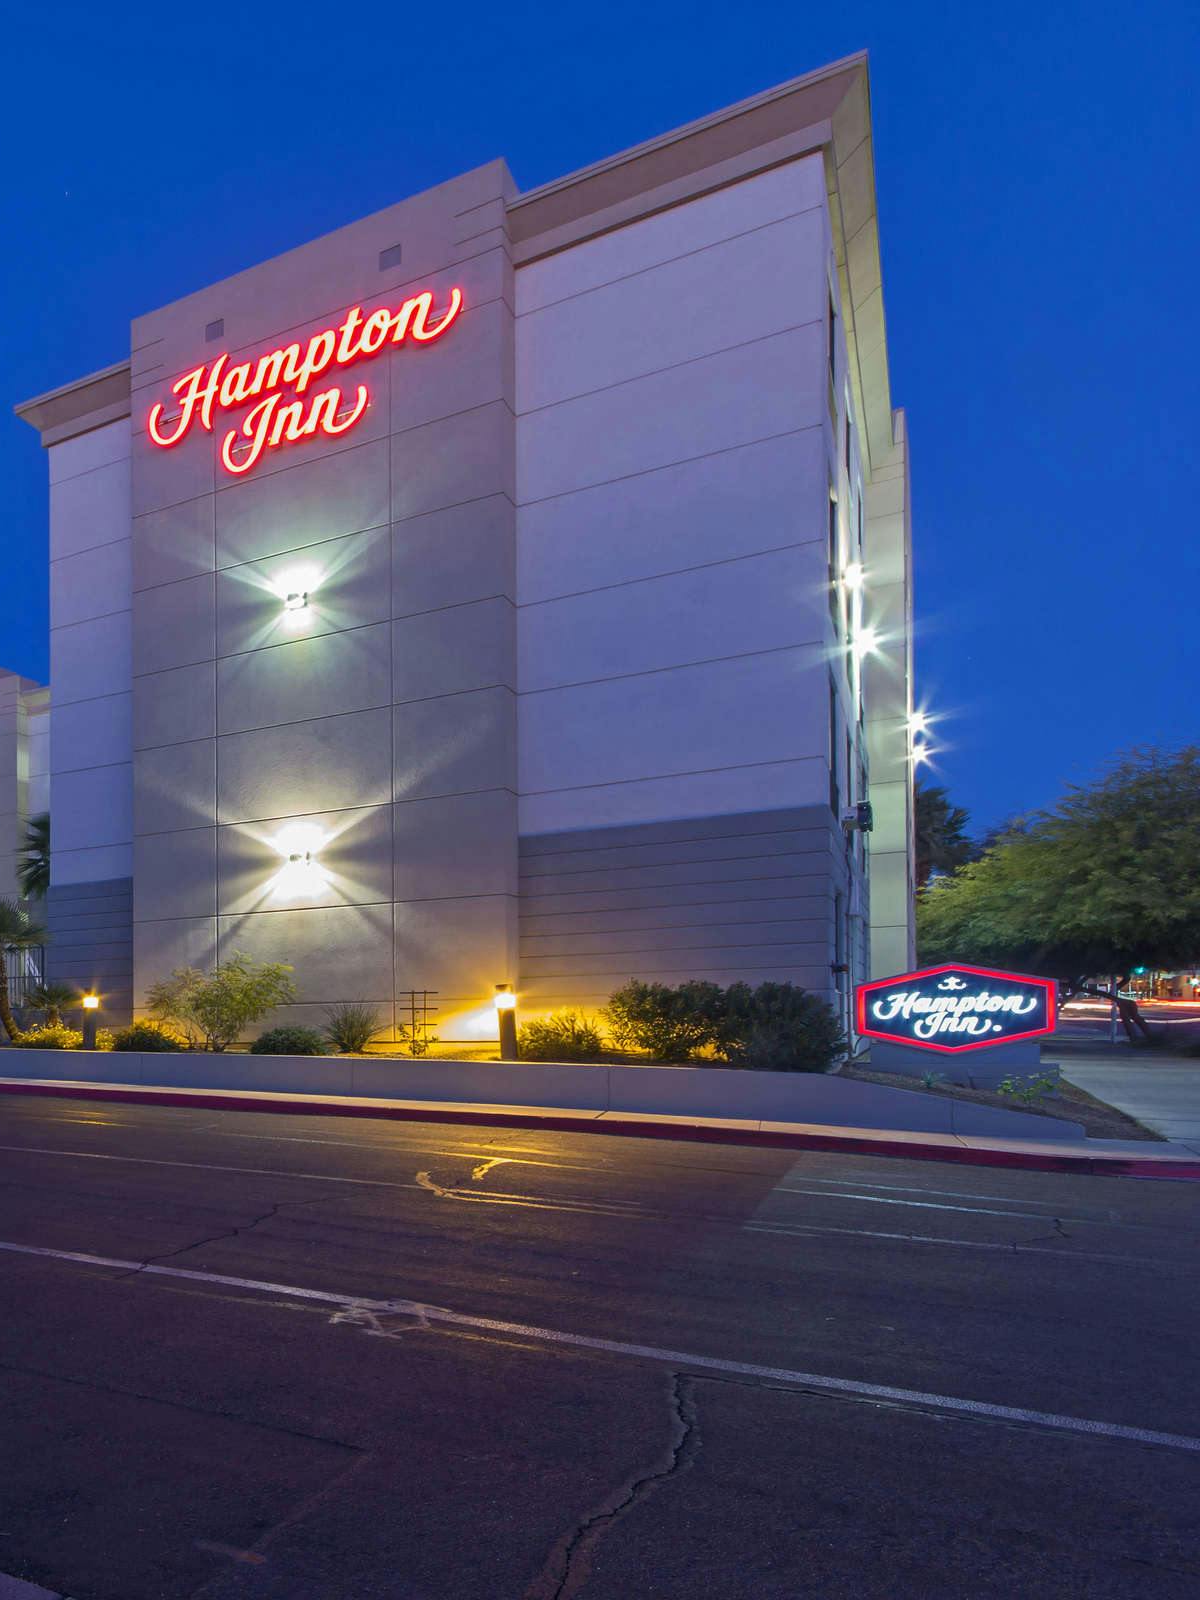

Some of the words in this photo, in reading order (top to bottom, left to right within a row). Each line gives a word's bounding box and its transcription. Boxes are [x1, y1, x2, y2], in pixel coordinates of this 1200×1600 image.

[148, 287, 462, 446] Hampton
[221, 385, 369, 474] Inn
[872, 991, 1038, 1020] Hampton
